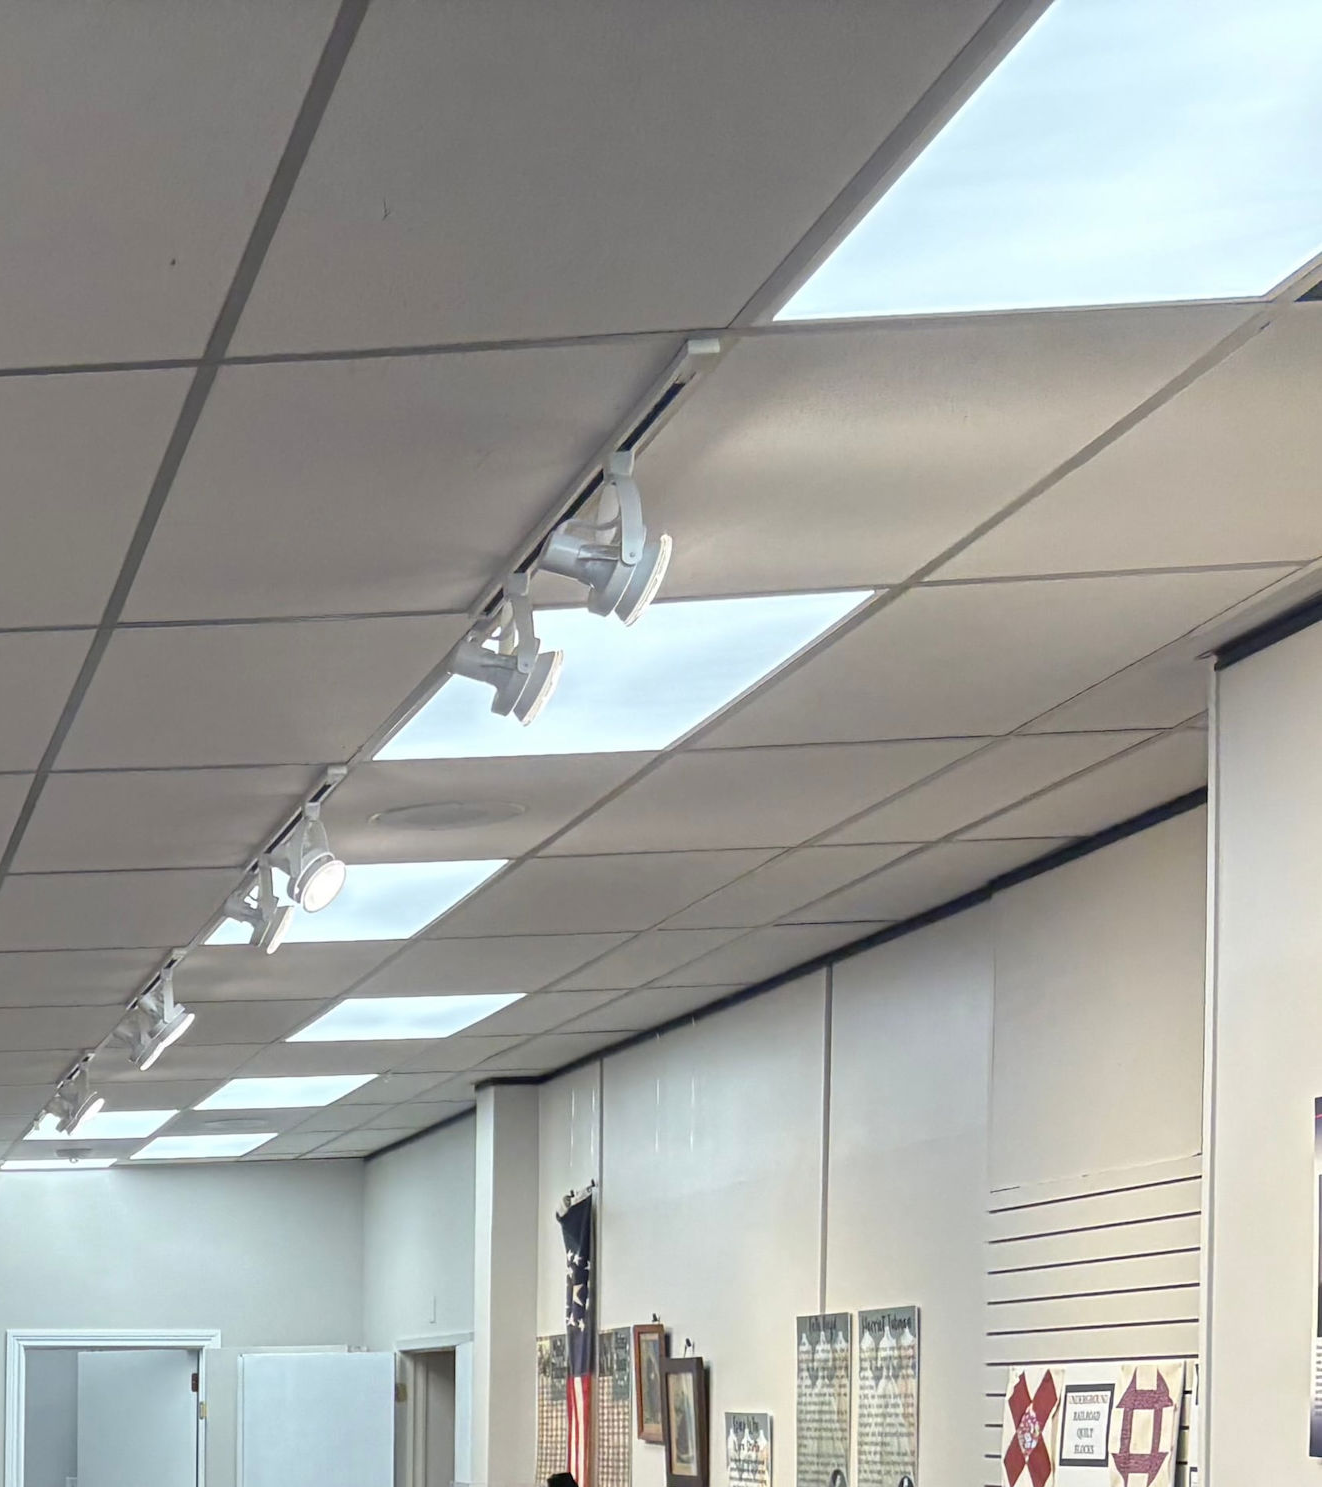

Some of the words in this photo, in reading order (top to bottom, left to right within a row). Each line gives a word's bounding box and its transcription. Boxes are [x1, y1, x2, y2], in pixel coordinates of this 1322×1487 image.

[1068, 1394, 1109, 1404] UNDERGROUND
[1073, 1411, 1101, 1421] RAILROAD
[1076, 1427, 1094, 1440] QUILT
[1074, 1444, 1095, 1455] BLOCKS
